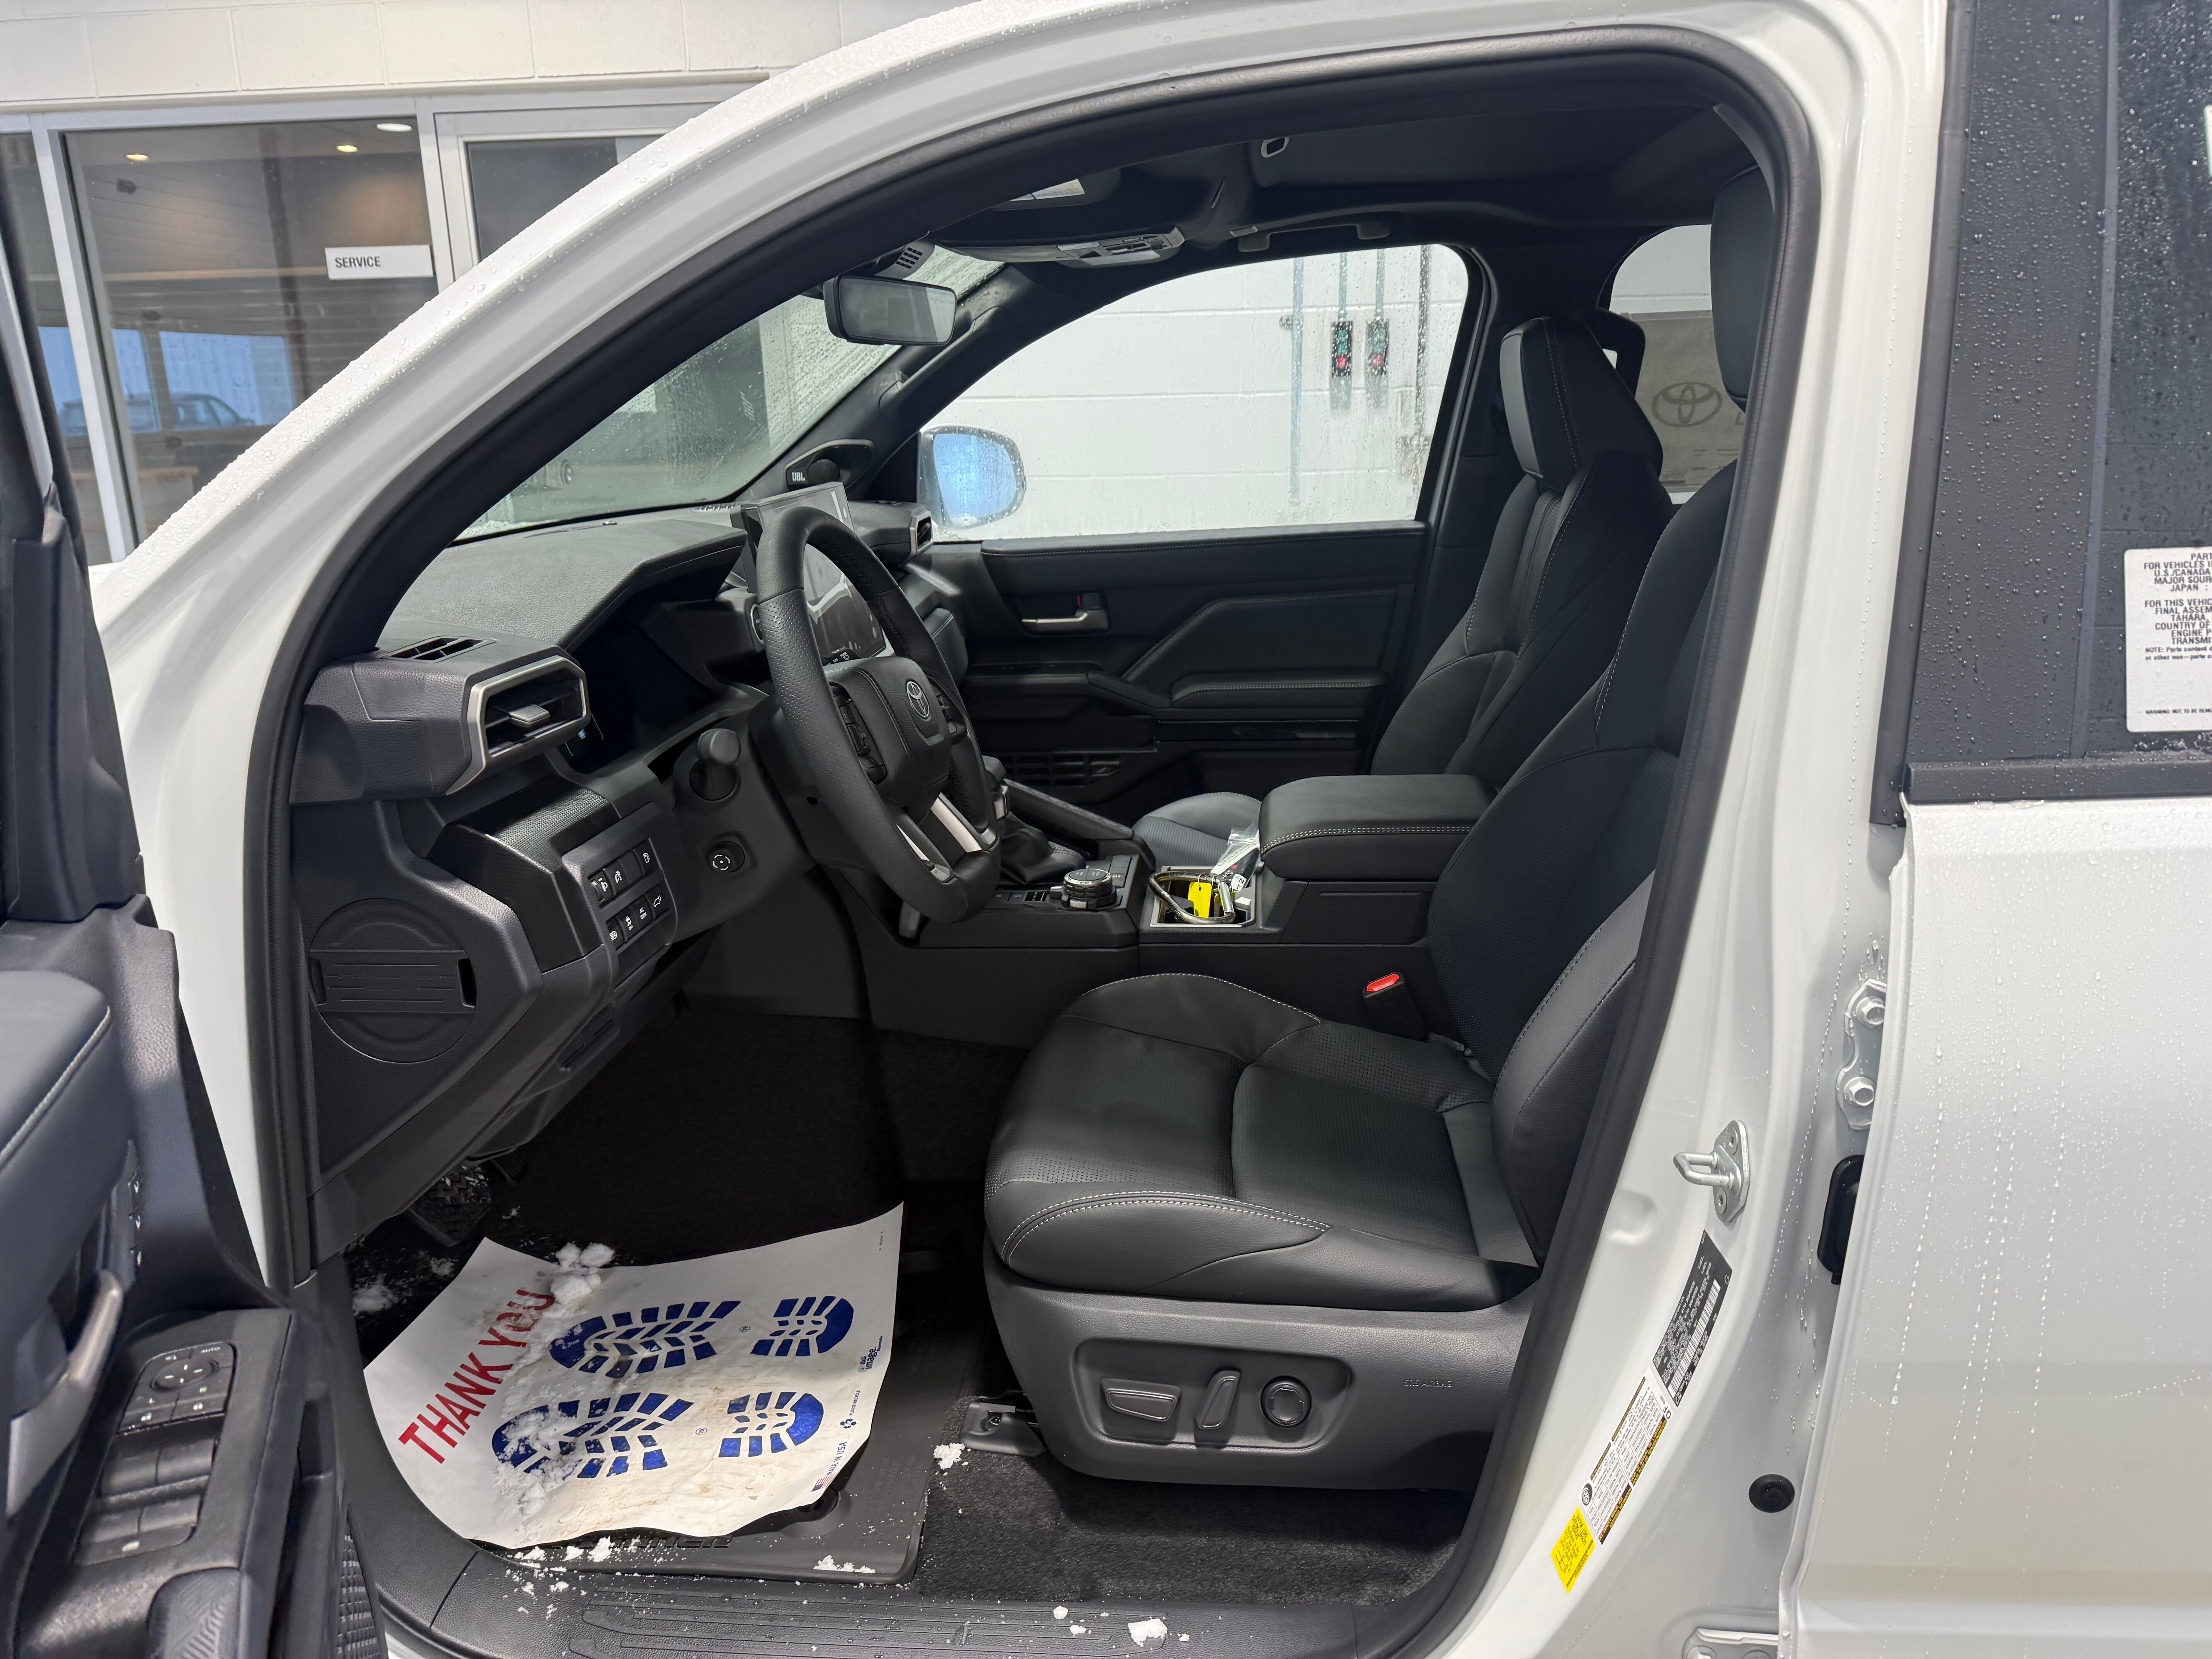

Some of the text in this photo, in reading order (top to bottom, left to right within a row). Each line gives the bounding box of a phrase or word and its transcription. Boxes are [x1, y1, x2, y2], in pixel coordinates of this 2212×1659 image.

[335, 256, 381, 268] SERVICE
[2164, 561, 2204, 569] VEHICLES
[2155, 620, 2210, 630] COUNTRY OF
[866, 1348, 877, 1369] image
[398, 1289, 555, 1464] THANK YOU
[825, 1462, 839, 1476] MADE
[836, 1441, 847, 1455] USA
